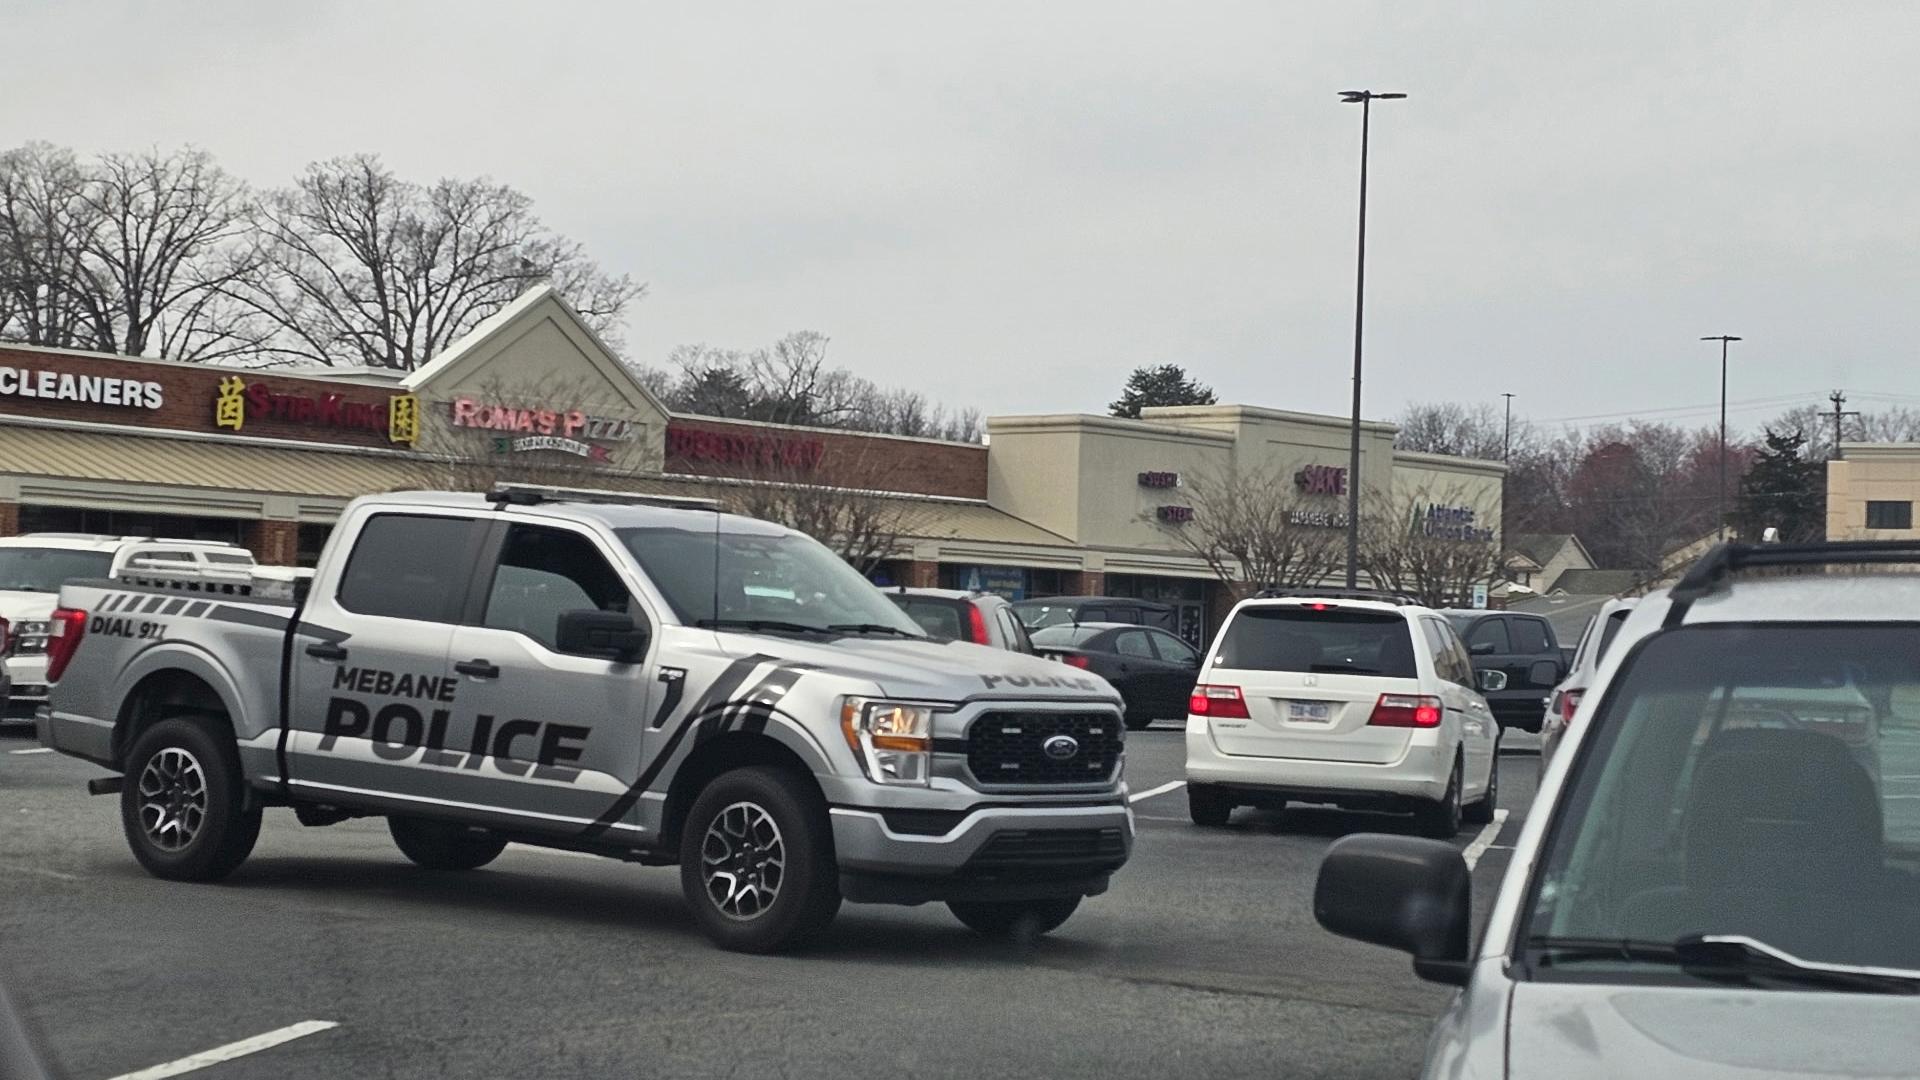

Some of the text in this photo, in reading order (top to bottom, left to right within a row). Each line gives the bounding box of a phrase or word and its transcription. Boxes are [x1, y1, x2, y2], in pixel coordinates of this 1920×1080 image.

[0, 366, 163, 409] CLEANERS
[1304, 465, 1348, 496] SAKE
[90, 615, 168, 640] DIAL 911
[332, 665, 459, 701] MEBANE
[978, 674, 1097, 691] POLICE
[316, 697, 594, 784] POLICE
